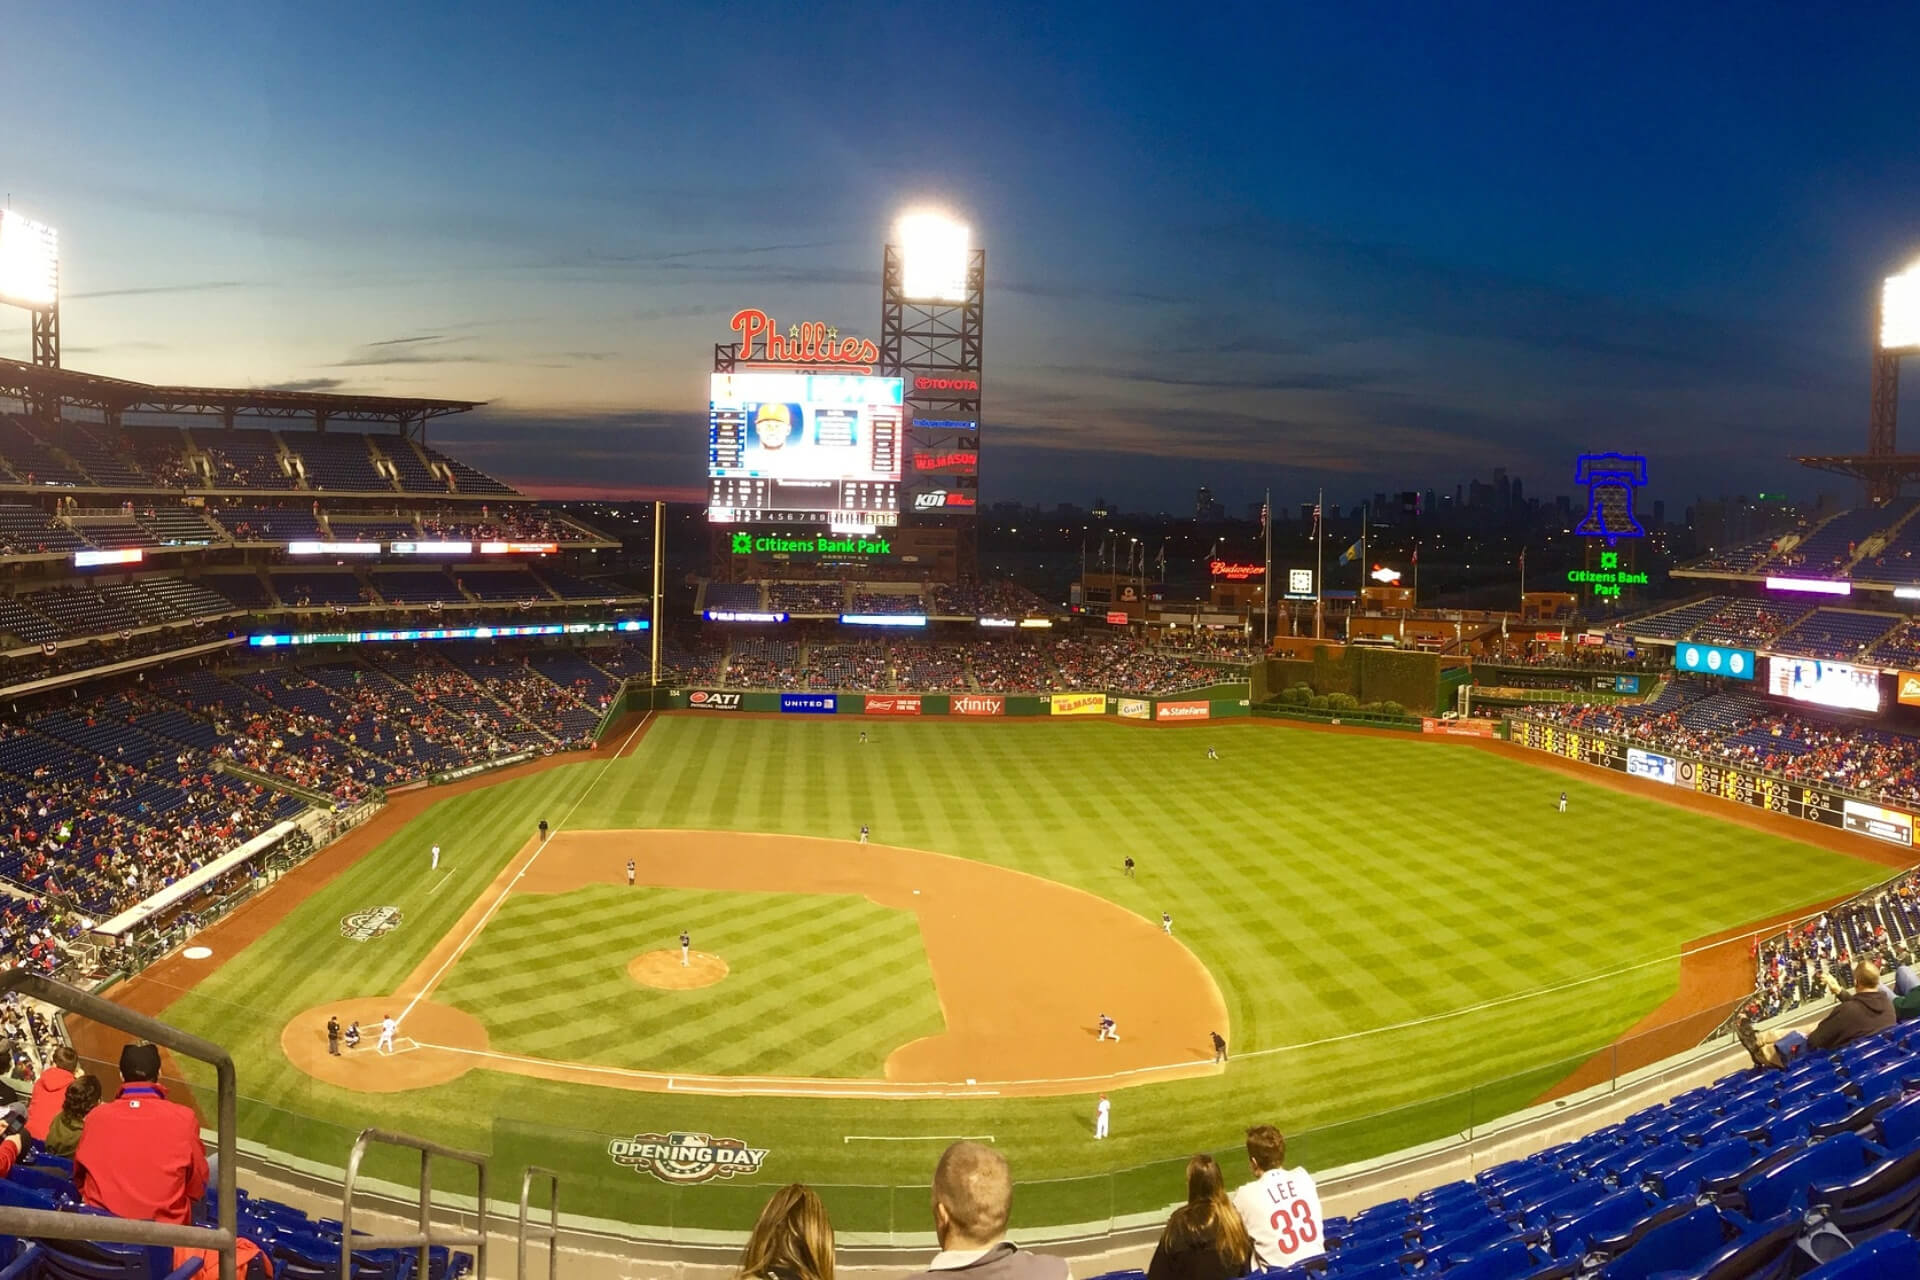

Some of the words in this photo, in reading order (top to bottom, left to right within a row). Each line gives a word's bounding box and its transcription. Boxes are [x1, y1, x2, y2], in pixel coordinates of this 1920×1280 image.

[731, 308, 879, 363] Phillies
[931, 379, 978, 391] TOYOTA
[756, 538, 814, 552] Citizens
[818, 538, 855, 553] Bank
[858, 540, 890, 554] Park
[1210, 561, 1266, 574] Budweiser
[1567, 570, 1616, 582] Citizens
[1618, 572, 1648, 584] Bank
[1594, 584, 1621, 596] Park
[706, 693, 741, 705] ATI
[954, 697, 1000, 714] xfinity
[1123, 703, 1144, 714] Gulf
[611, 1141, 712, 1163] OPENING
[716, 1149, 767, 1165] DAY
[1267, 1180, 1297, 1204] LEE
[1270, 1199, 1317, 1255] 33
